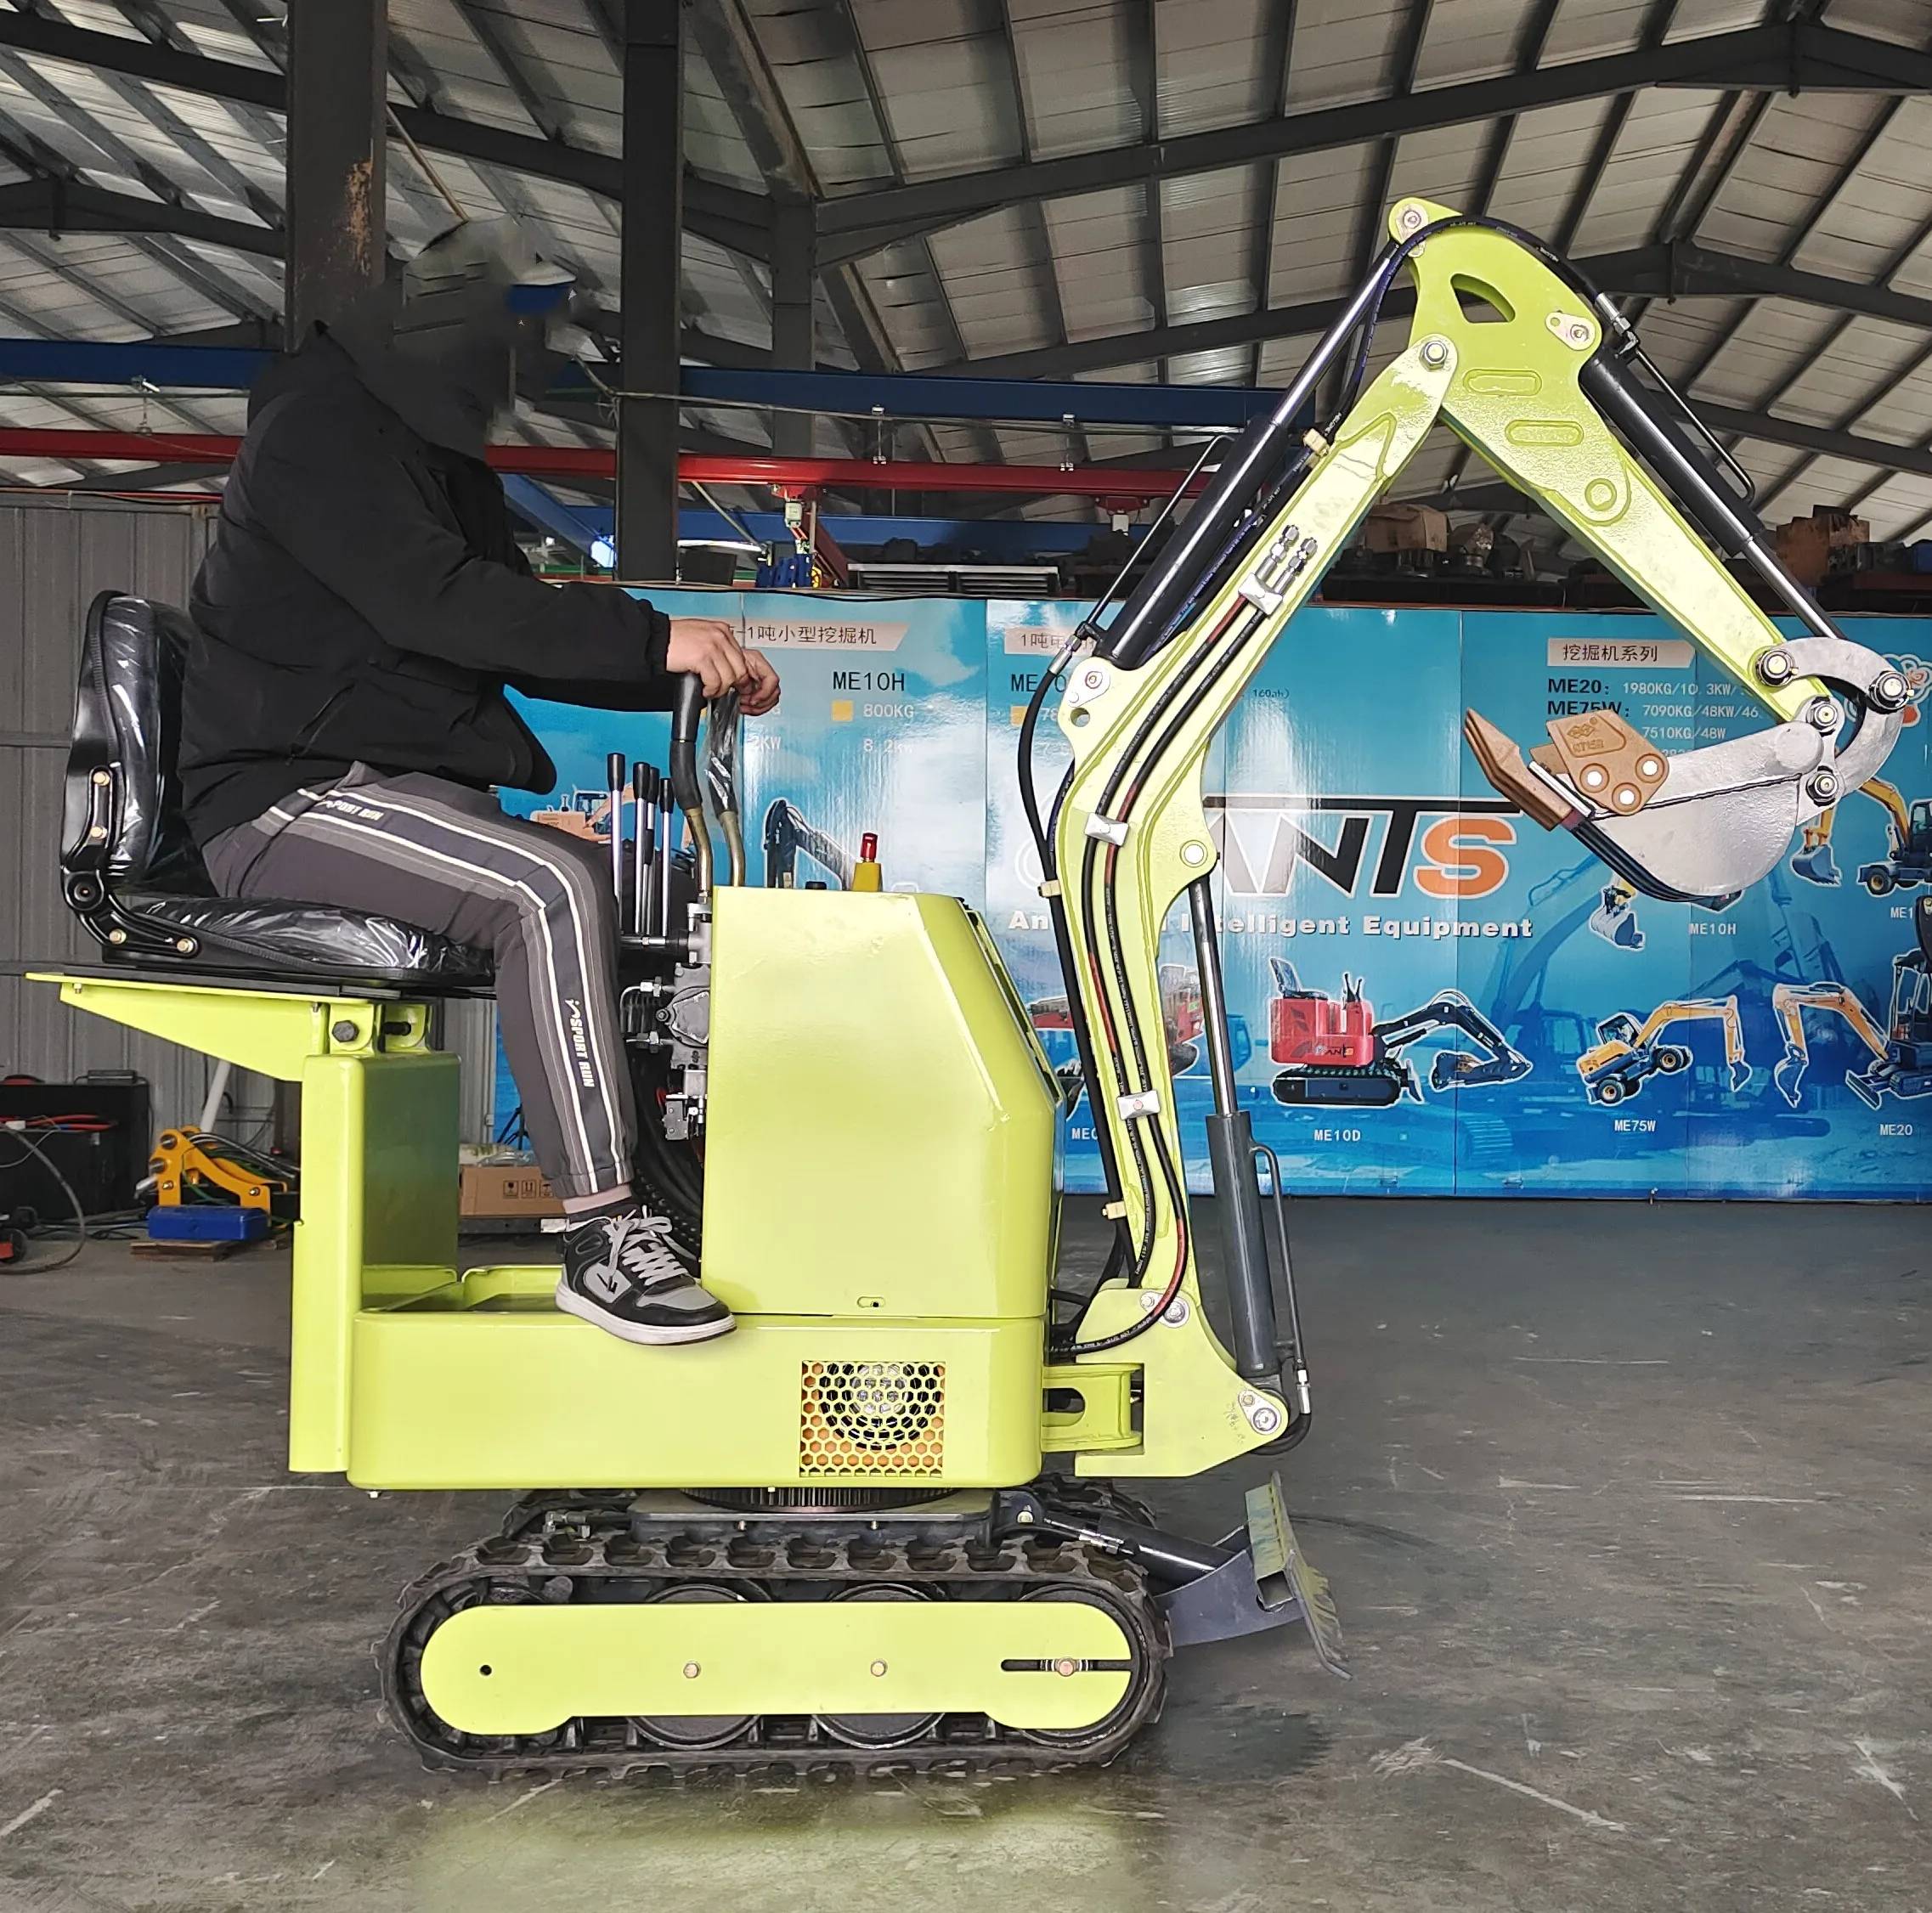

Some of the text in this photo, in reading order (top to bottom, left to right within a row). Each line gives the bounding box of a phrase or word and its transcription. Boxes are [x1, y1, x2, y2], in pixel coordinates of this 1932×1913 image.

[1562, 643, 1658, 663] 挖掘机系列
[833, 671, 905, 691] ME10H
[1011, 674, 1067, 693] ME0
[863, 703, 915, 719] 800KG
[1890, 906, 1914, 919] ME1
[1008, 910, 1050, 930] An
[1362, 915, 1533, 940] Equipment
[1689, 923, 1737, 936] ME10H
[569, 1018, 596, 1087] SPORT RUN
[1614, 1120, 1657, 1132] ME75W
[1879, 1123, 1913, 1137] ME20
[1313, 1129, 1361, 1142] ME10D
